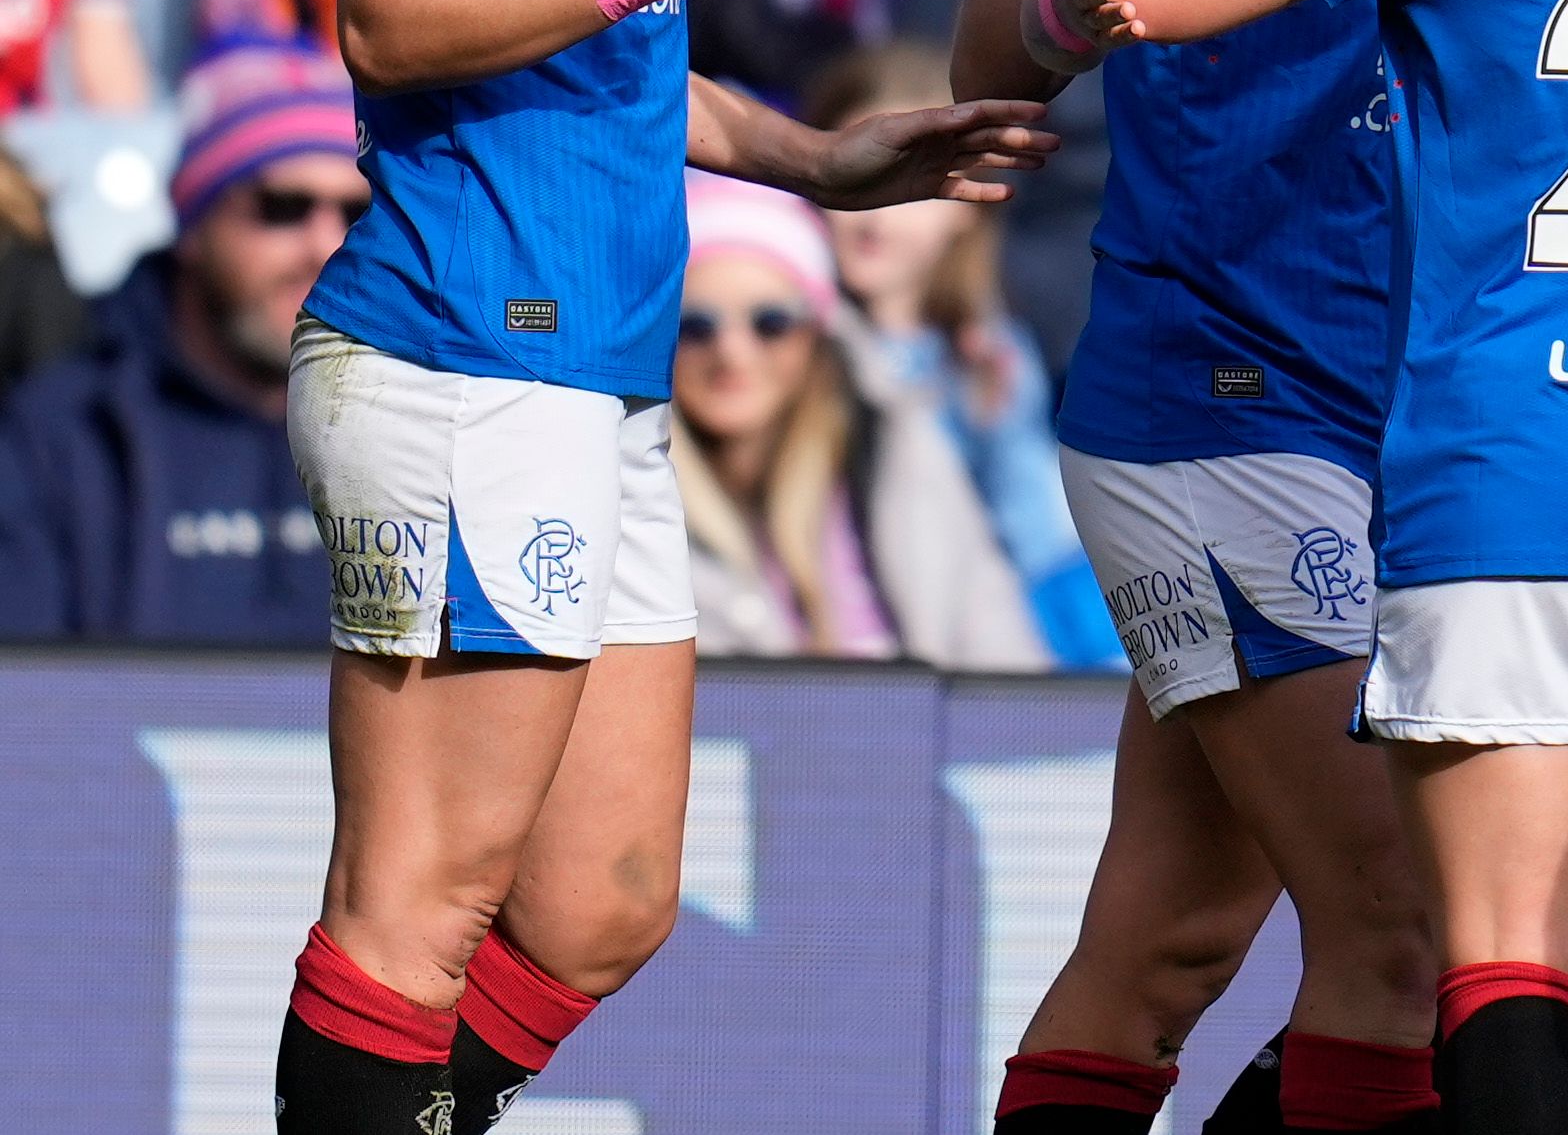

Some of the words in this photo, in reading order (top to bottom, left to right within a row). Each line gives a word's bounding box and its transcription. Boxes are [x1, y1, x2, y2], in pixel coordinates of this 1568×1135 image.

[313, 511, 428, 558] OLTON
[1104, 564, 1194, 629] MOLTON
[1121, 607, 1210, 670] BROWN
